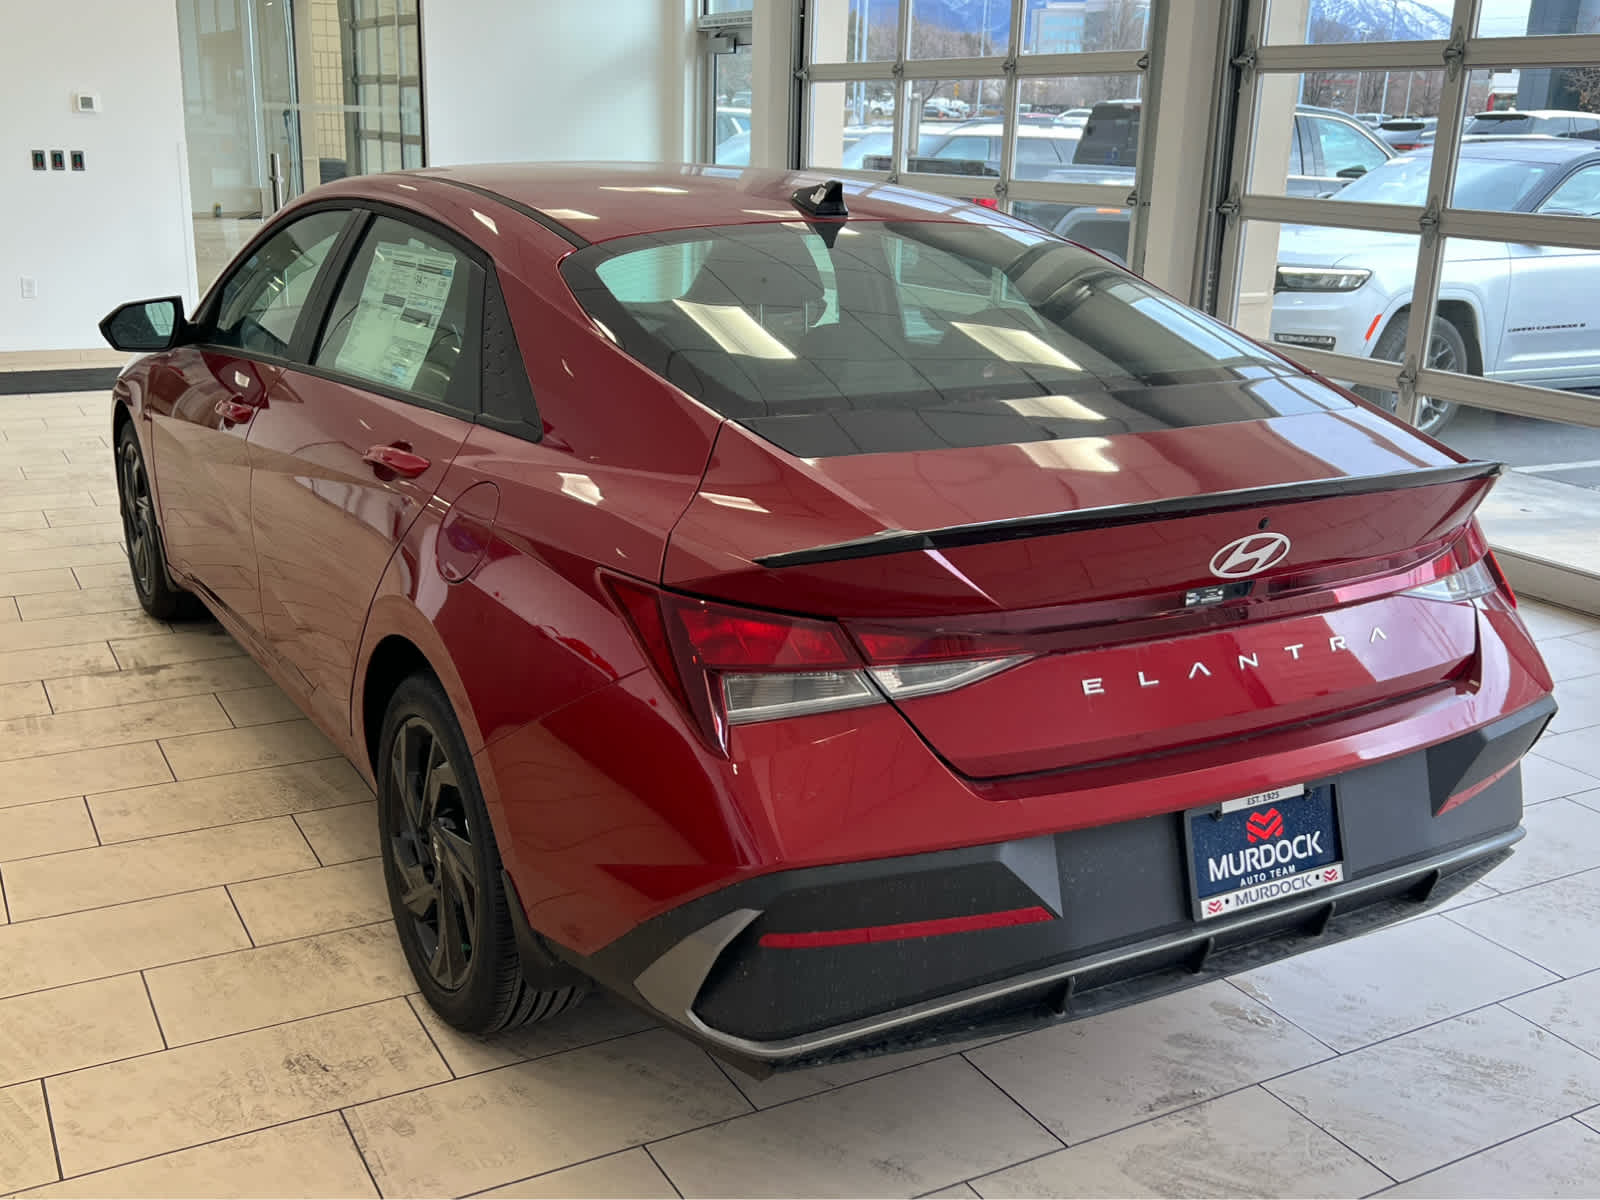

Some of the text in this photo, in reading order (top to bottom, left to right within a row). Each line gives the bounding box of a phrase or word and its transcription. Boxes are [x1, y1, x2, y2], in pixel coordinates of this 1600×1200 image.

[1081, 627, 1387, 695] ELANTRA
[1262, 791, 1280, 802] 1925
[1207, 830, 1323, 882] MURDOCK
[1235, 874, 1312, 907] MURDOCK
[1240, 864, 1296, 888] AUTO TEAM
